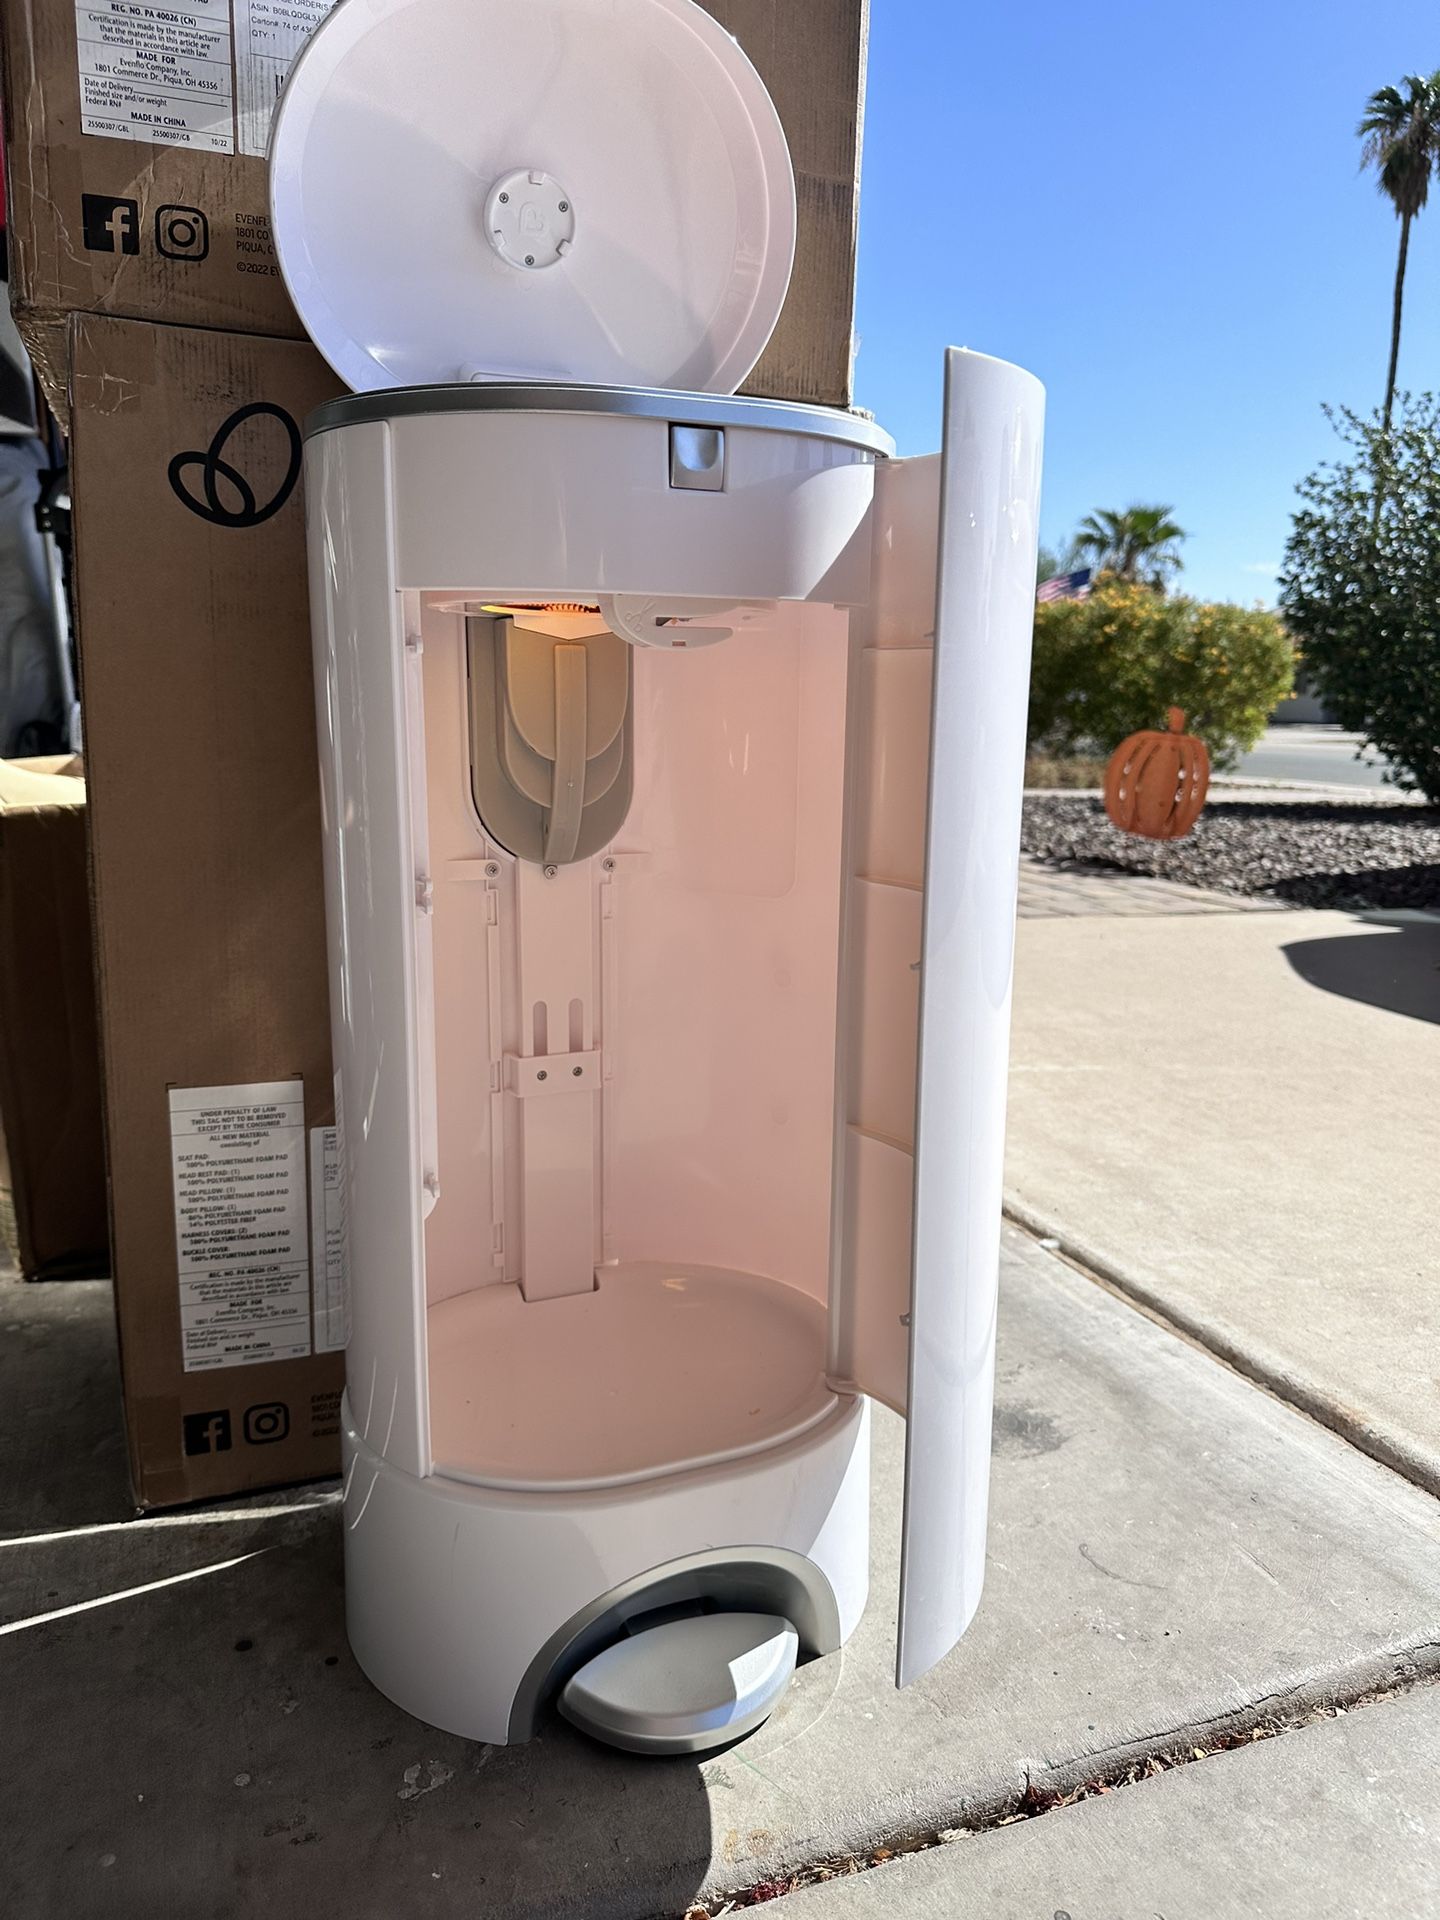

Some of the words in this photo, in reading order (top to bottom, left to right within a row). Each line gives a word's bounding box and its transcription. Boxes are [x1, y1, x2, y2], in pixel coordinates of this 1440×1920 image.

[130, 6, 143, 16] NO.
[144, 9, 154, 18] PA
[156, 12, 179, 22] 40026
[180, 16, 197, 28] (CN)
[88, 12, 129, 26] Certification
[130, 20, 136, 28] is
[136, 22, 156, 32] made
[156, 24, 164, 34] by
[166, 26, 176, 36] the
[178, 30, 220, 43] manufacturer
[100, 24, 114, 34] that
[114, 27, 126, 36] the
[128, 29, 158, 40] materials
[158, 34, 165, 42] in
[166, 36, 178, 45] this
[179, 38, 200, 48] article
[102, 34, 134, 46] described
[135, 39, 142, 47] in
[143, 41, 180, 54] accordance
[180, 48, 195, 56] with
[196, 49, 209, 58] law.
[136, 50, 158, 62] MADE
[162, 55, 176, 65] FOR
[120, 57, 145, 70] Evenflo
[146, 62, 178, 76] Company,
[180, 67, 193, 77] Inc.
[94, 62, 111, 73] 1801
[112, 66, 149, 80] Commerce
[163, 74, 184, 86] Piqua,
[185, 78, 196, 87] OH
[198, 80, 218, 91] 45356
[84, 77, 100, 88] Date
[100, 80, 108, 88] of
[108, 82, 134, 94] Delivery
[85, 86, 110, 98] Finished
[111, 91, 123, 100] size
[124, 94, 145, 104] and/or
[146, 97, 167, 108] weight
[85, 96, 108, 106] Federal
[130, 111, 152, 122] MADE
[154, 114, 162, 124] IN
[163, 116, 186, 128] CHINA
[211, 138, 228, 147] 10/22
[235, 226, 255, 239] 1801
[256, 1112, 286, 1120] REMOVED
[198, 1124, 220, 1132] EXCEPT
[246, 1120, 280, 1128] CONSUMER
[238, 1130, 270, 1138] MATERIAL
[206, 1156, 254, 1168] POLYURETHANE
[256, 1154, 274, 1162] FOAM
[206, 1174, 254, 1184] POLYURETHANE
[256, 1172, 274, 1180] FOAM
[208, 1192, 256, 1202] POLYURETHANE
[257, 1189, 276, 1197] FOAM
[204, 1209, 252, 1220] POLYURETHANE
[254, 1207, 272, 1215] FOAM
[204, 1218, 238, 1227] POLYESTER
[182, 1230, 210, 1239] HARNESS
[209, 1234, 256, 1244] POLYURETHANE
[258, 1231, 276, 1239] FOAM
[182, 1248, 206, 1256] BUCKLE
[210, 1250, 257, 1260] POLYURETHANE
[258, 1248, 277, 1256] FOAM
